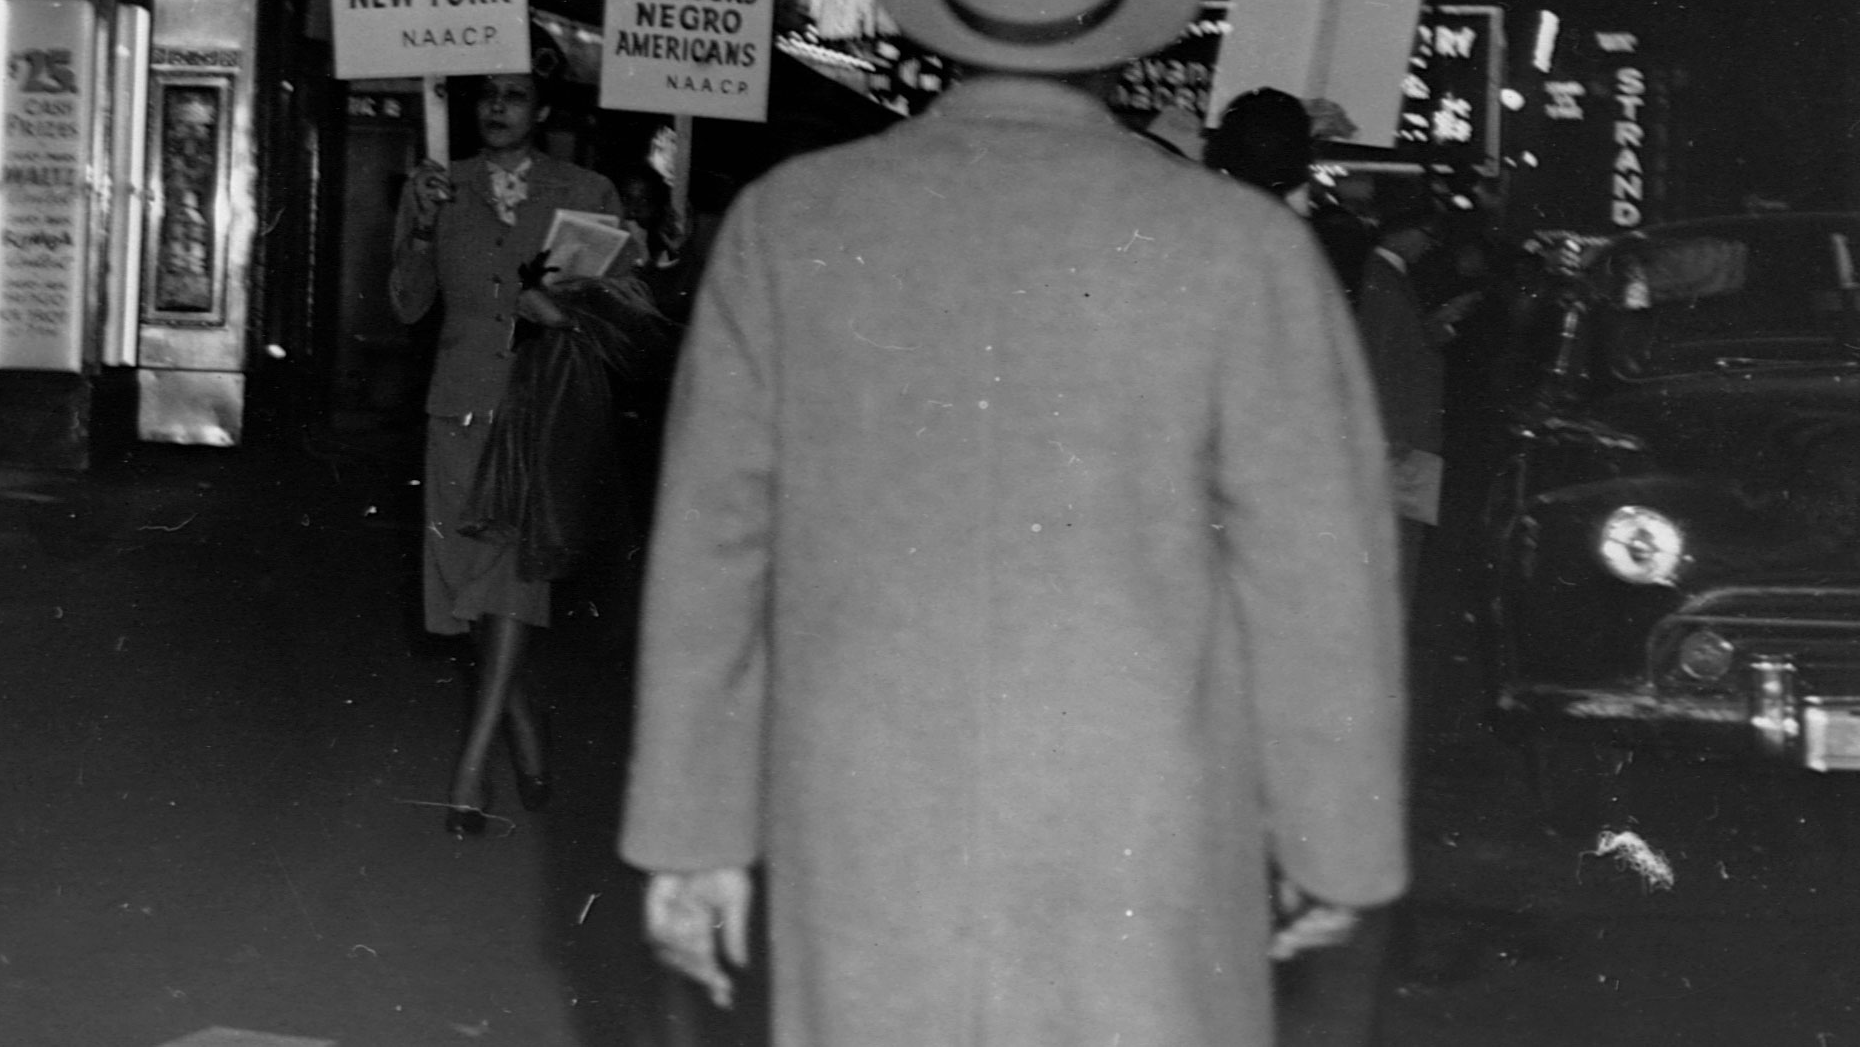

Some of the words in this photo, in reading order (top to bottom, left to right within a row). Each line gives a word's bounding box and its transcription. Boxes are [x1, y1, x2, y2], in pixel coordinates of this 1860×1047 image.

[635, 2, 743, 35] NEGRO
[615, 31, 757, 68] AMERICANS
[1612, 66, 1646, 227] STRAND
